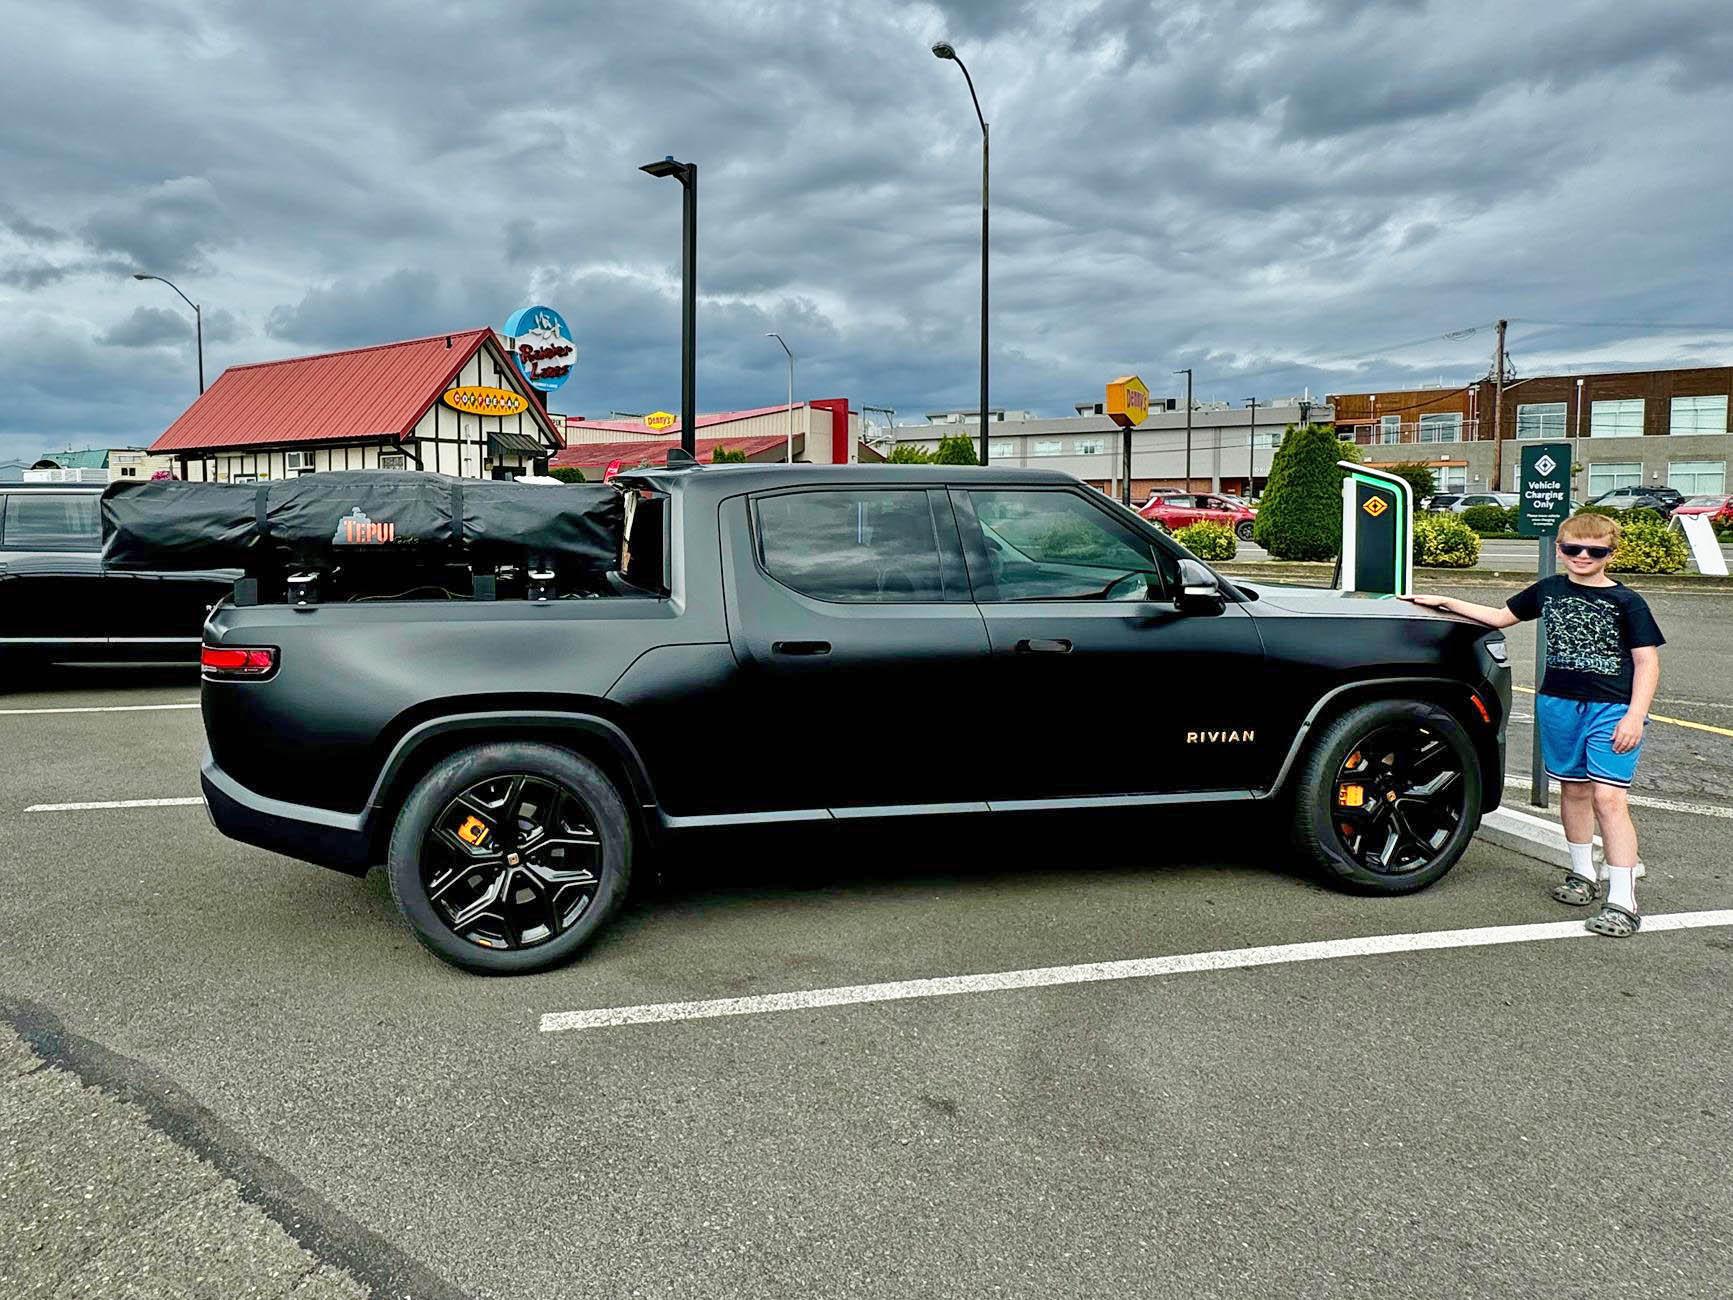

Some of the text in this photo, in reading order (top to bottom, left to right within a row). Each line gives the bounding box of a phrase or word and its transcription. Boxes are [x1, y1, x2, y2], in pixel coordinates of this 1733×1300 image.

[1126, 388, 1147, 412] Denny's
[647, 415, 672, 426] Denny's
[1528, 481, 1561, 490] Vehicle
[1524, 490, 1564, 501] Charging
[1533, 500, 1555, 510] Only
[343, 520, 395, 544] TEPUI
[1186, 730, 1255, 744] RIVIAN
